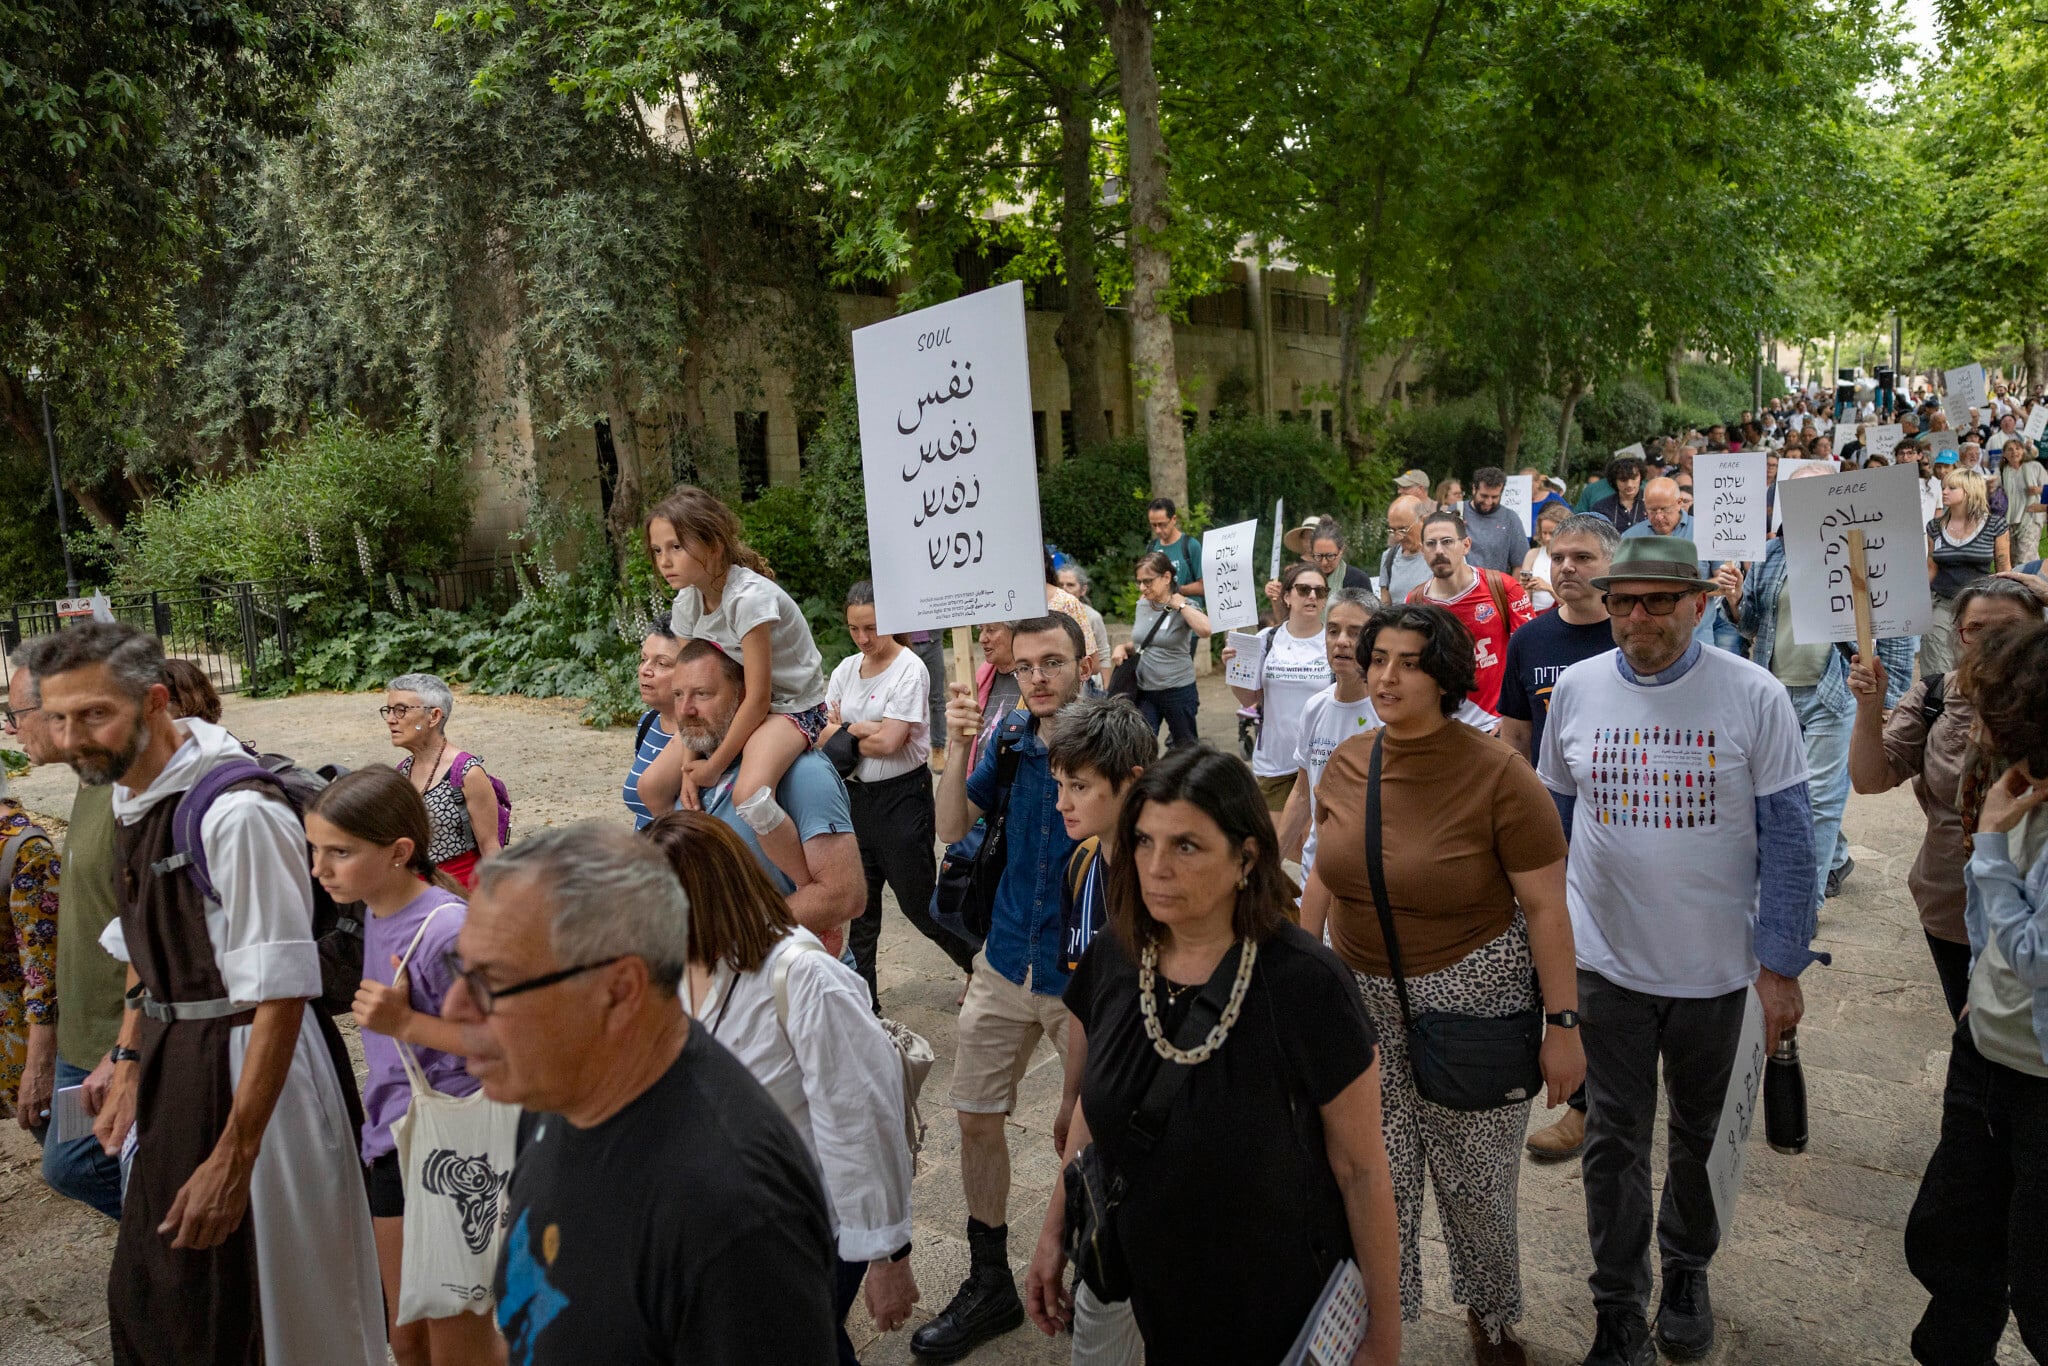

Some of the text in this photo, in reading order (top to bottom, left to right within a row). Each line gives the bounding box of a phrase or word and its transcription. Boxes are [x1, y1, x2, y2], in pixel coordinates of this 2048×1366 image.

[918, 326, 952, 352] SOUL
[897, 359, 974, 435] نفس
[1719, 461, 1740, 469] PEACE
[1714, 475, 1745, 489] שלום
[1828, 482, 1867, 496] PEACE
[1819, 504, 1883, 542] سلام
[1713, 528, 1747, 549] سلام
[928, 529, 984, 571] נפש
[1215, 544, 1239, 560] שלום
[1830, 590, 1888, 613] שום
